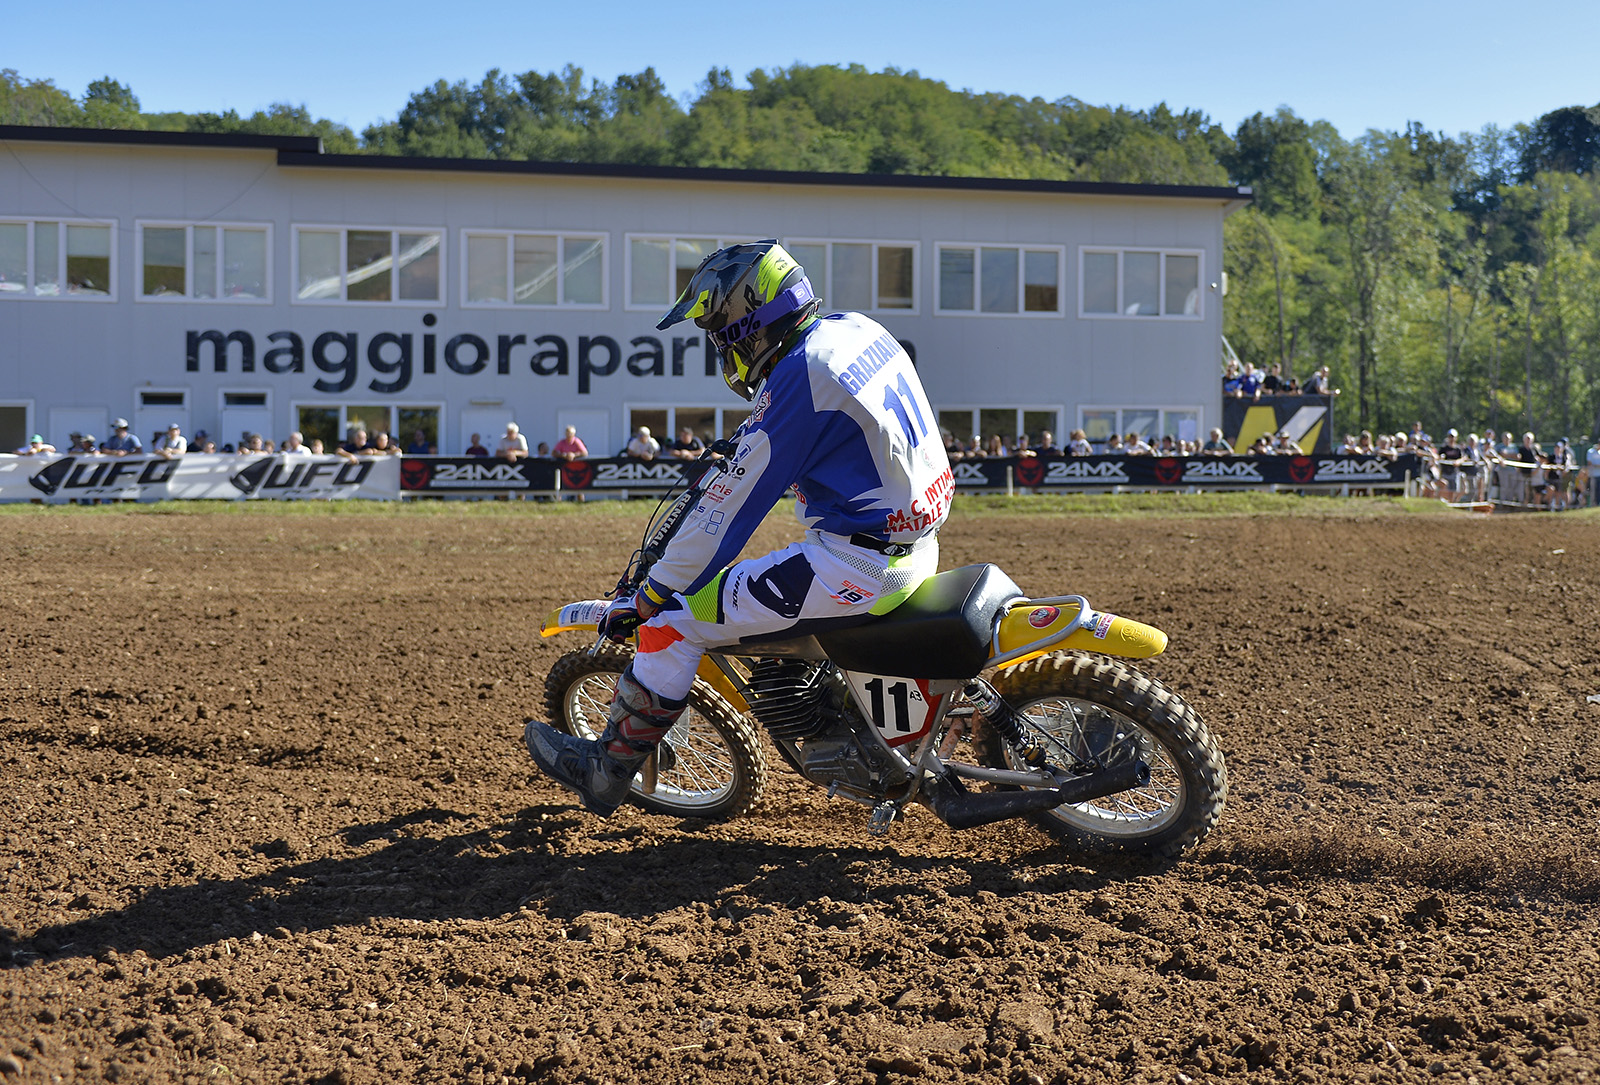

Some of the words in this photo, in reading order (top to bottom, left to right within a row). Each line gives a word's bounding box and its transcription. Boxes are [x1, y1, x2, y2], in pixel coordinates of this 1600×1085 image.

[839, 332, 902, 396] GRAZIANI
[883, 372, 929, 449] 11
[62, 458, 183, 488] UFO
[262, 461, 376, 488] UFO
[435, 463, 526, 480] 24MX
[596, 463, 684, 479] 24MX
[1047, 461, 1126, 477] 24MX
[1185, 461, 1259, 477] 24MX
[1318, 459, 1388, 475] 24MX
[649, 492, 692, 548] RENTHAL
[864, 677, 911, 733] 11
